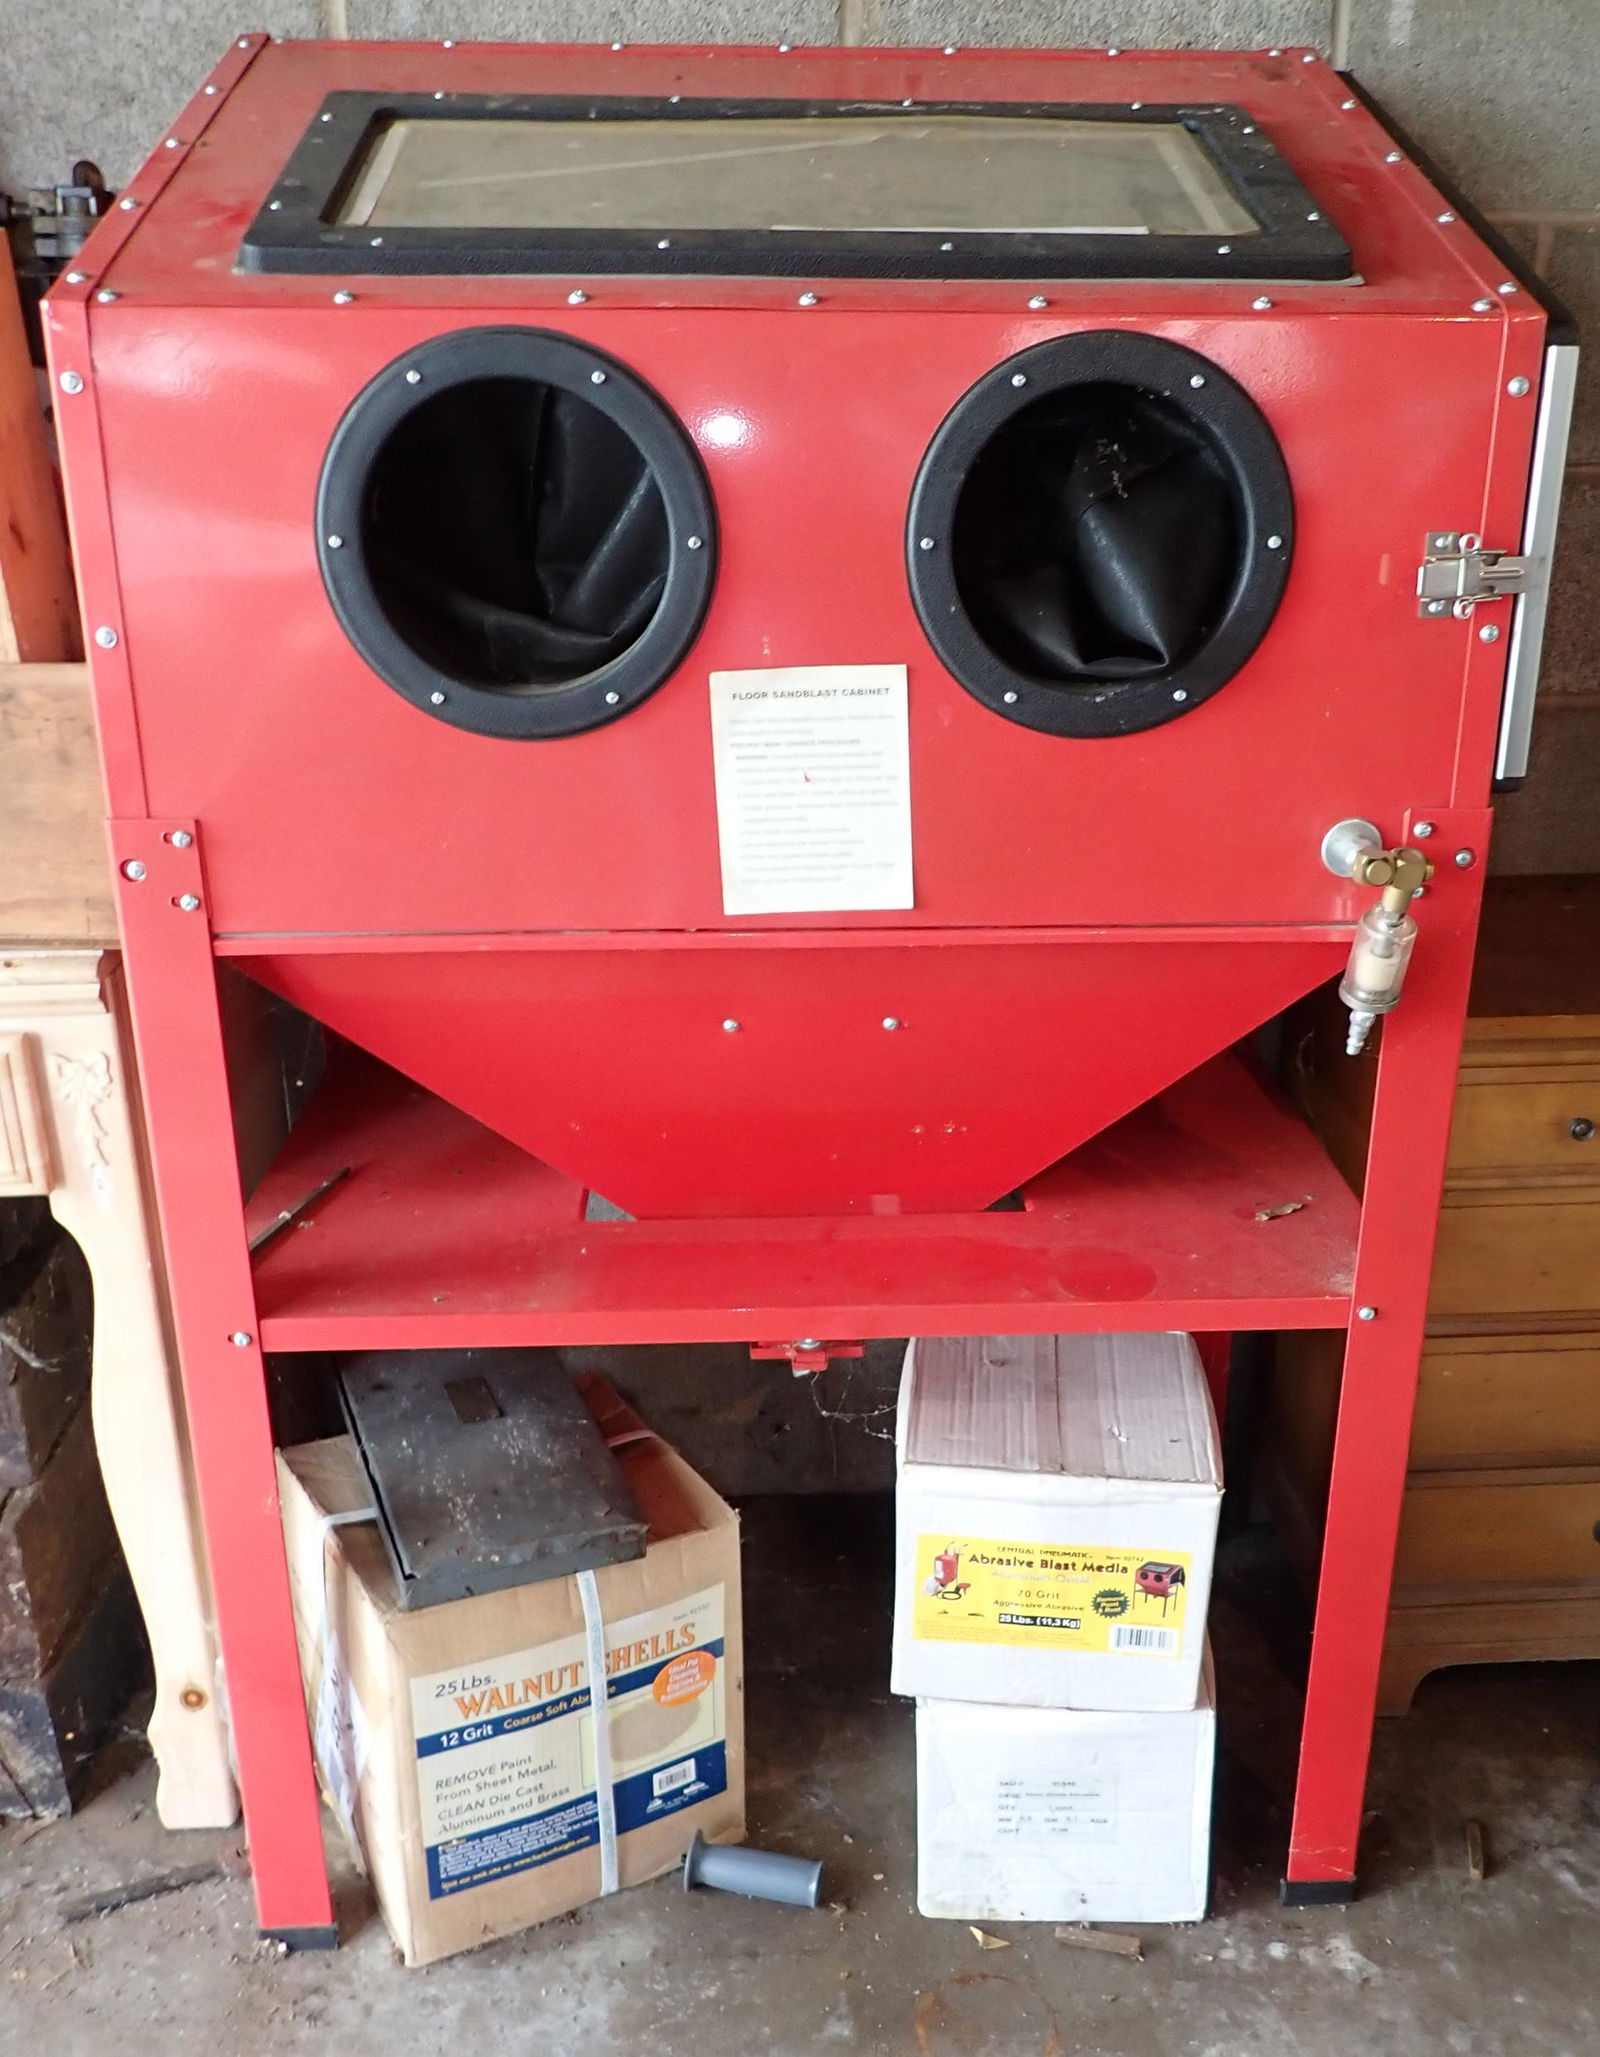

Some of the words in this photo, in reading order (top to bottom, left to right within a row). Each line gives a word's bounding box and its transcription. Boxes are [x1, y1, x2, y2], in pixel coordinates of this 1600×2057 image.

[732, 691, 768, 700] FLOOR
[772, 689, 837, 698] SANDBLAST
[842, 687, 890, 696] CABINET
[969, 1553, 1034, 1569] Abrasive
[1040, 1558, 1077, 1572] Blast
[1081, 1562, 1129, 1574] Media
[1018, 1590, 1031, 1599] 70
[1036, 1590, 1060, 1600] Grit
[1000, 1614, 1011, 1623] 25
[435, 1682, 457, 1699] 25
[454, 1660, 584, 1720] WALNUT
[440, 1730, 460, 1748] 12
[463, 1722, 493, 1742] Grit
[503, 1711, 544, 1730] Coarse
[546, 1700, 568, 1717] Soft
[435, 1764, 497, 1790] REMOVE
[500, 1755, 532, 1771] Paint
[436, 1787, 471, 1804] From
[475, 1775, 513, 1793] Sheet
[438, 1798, 486, 1822] CLEAN
[489, 1793, 512, 1807] Die
[515, 1782, 544, 1798] Cast
[438, 1807, 506, 1836] Aluminum
[509, 1797, 533, 1813] and
[538, 1786, 571, 1804] Brass
